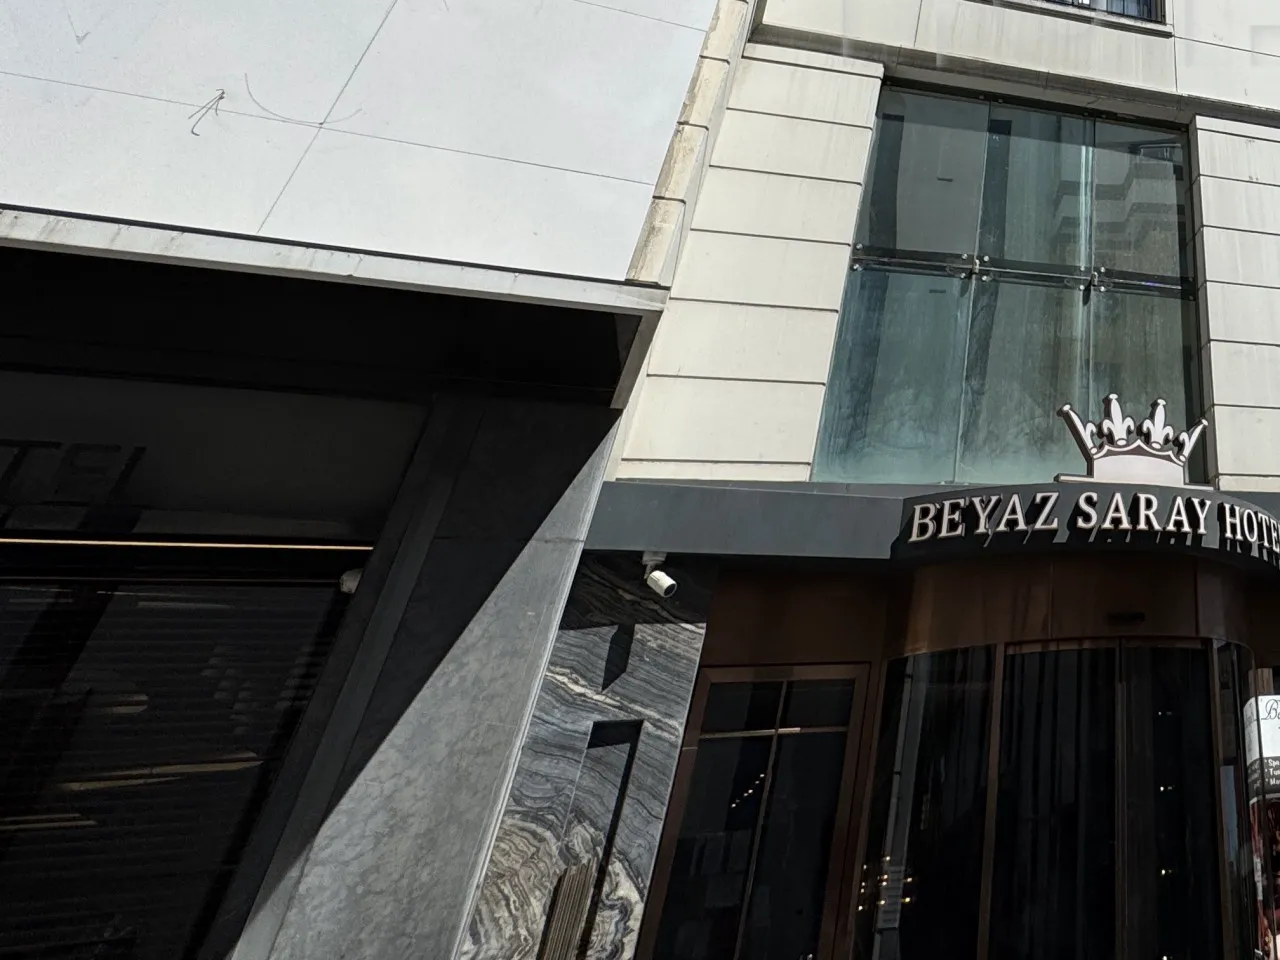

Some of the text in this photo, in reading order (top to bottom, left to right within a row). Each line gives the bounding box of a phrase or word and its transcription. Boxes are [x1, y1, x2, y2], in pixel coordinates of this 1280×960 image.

[908, 492, 1060, 542] BEYAZ
[1076, 492, 1212, 536] SARAY
[1268, 758, 1280, 768] Spa
